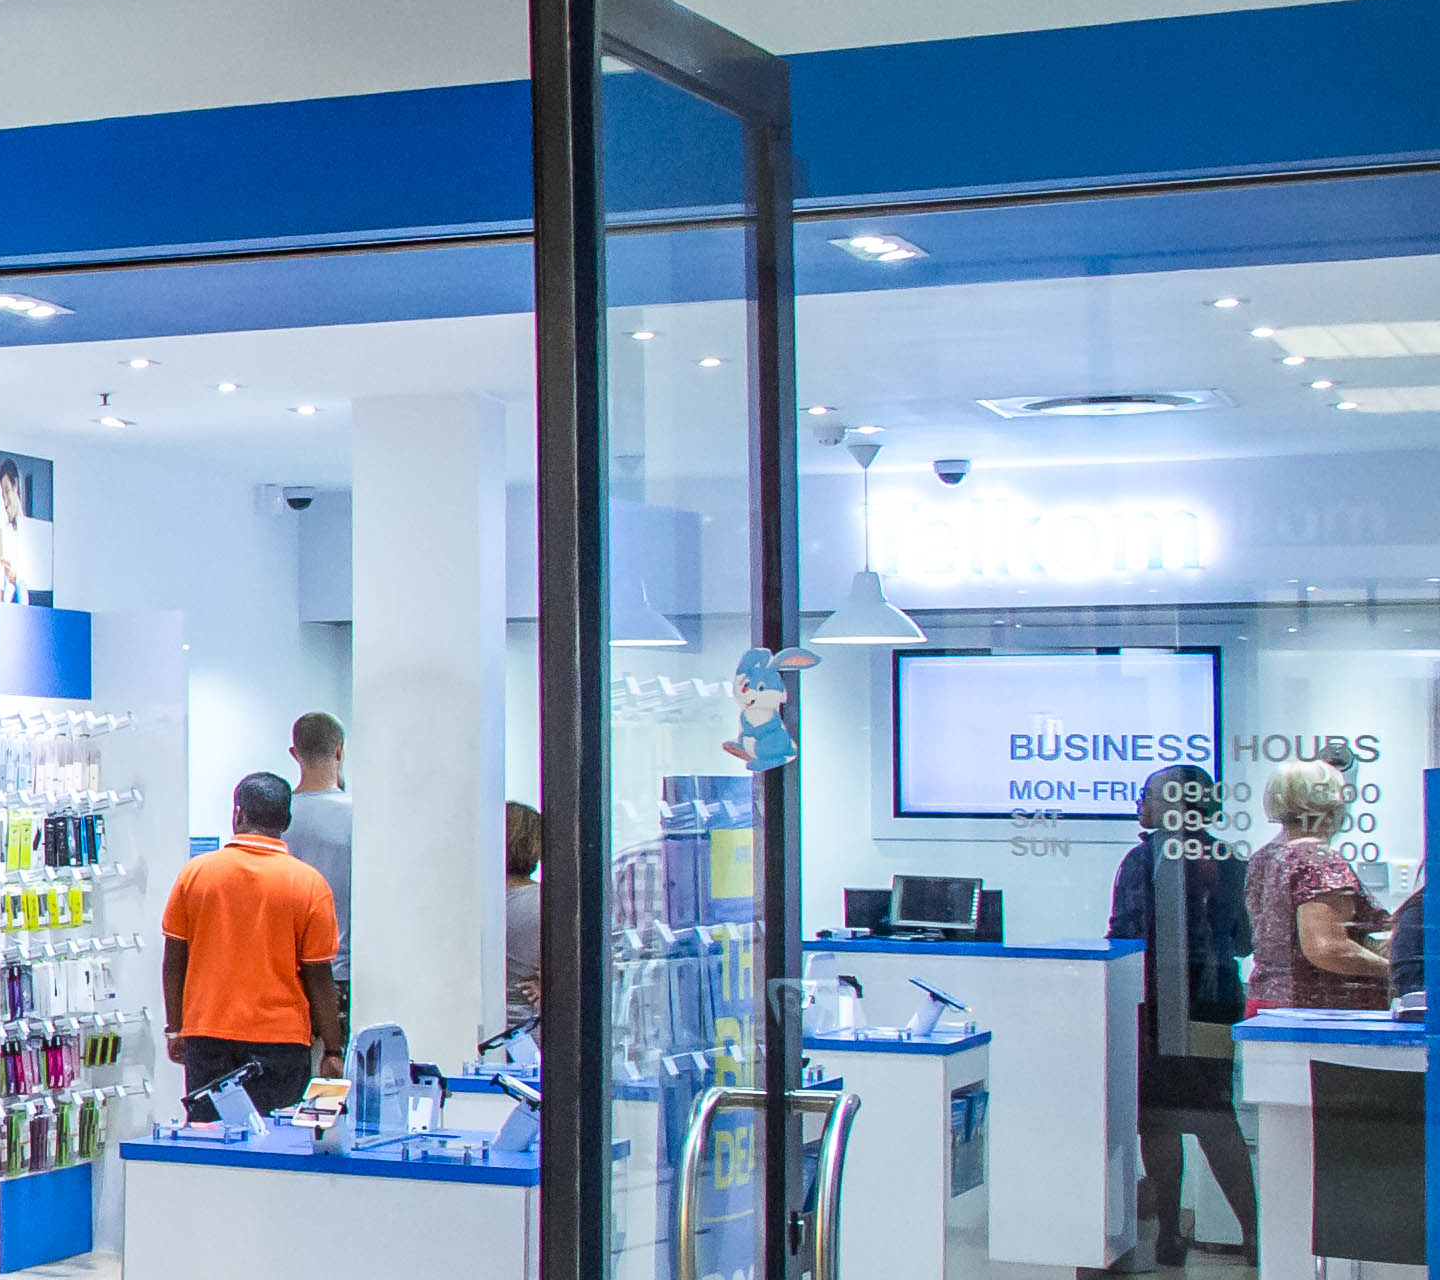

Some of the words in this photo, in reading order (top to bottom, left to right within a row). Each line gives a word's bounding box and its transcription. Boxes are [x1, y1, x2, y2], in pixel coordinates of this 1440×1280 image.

[1009, 733, 1212, 762] BUSINESS
[1233, 734, 1381, 763] HOURS
[1009, 780, 1137, 802] MON-FRI
[1162, 780, 1252, 804] 09:00
[1010, 807, 1063, 828] SAT
[1162, 809, 1252, 832] 09:00
[1010, 836, 1071, 858] SUN
[1162, 838, 1252, 862] 09:00
